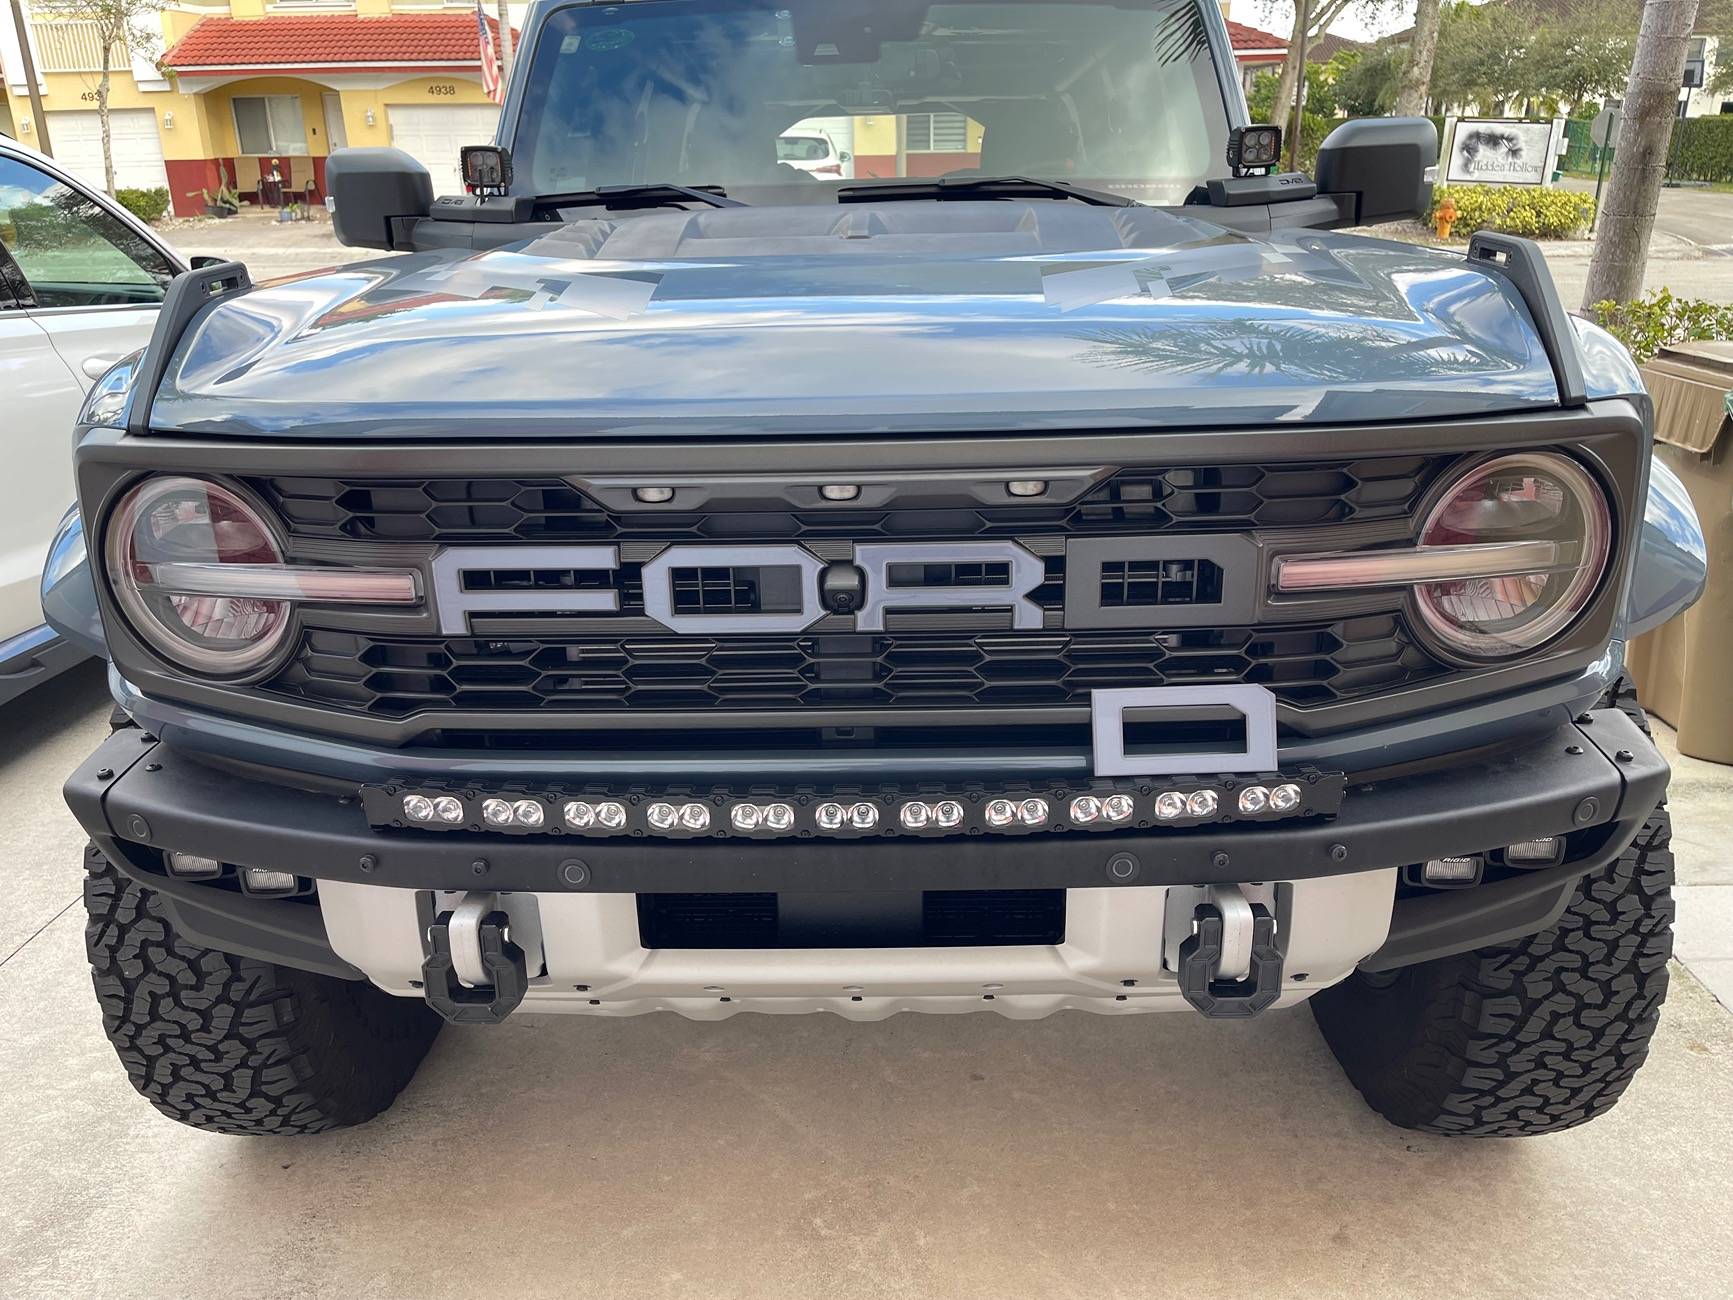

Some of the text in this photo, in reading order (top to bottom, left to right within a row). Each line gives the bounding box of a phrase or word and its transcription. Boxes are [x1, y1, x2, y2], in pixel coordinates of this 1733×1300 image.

[427, 85, 456, 96] 4938
[80, 91, 101, 102] 493
[432, 533, 1258, 635] FORD
